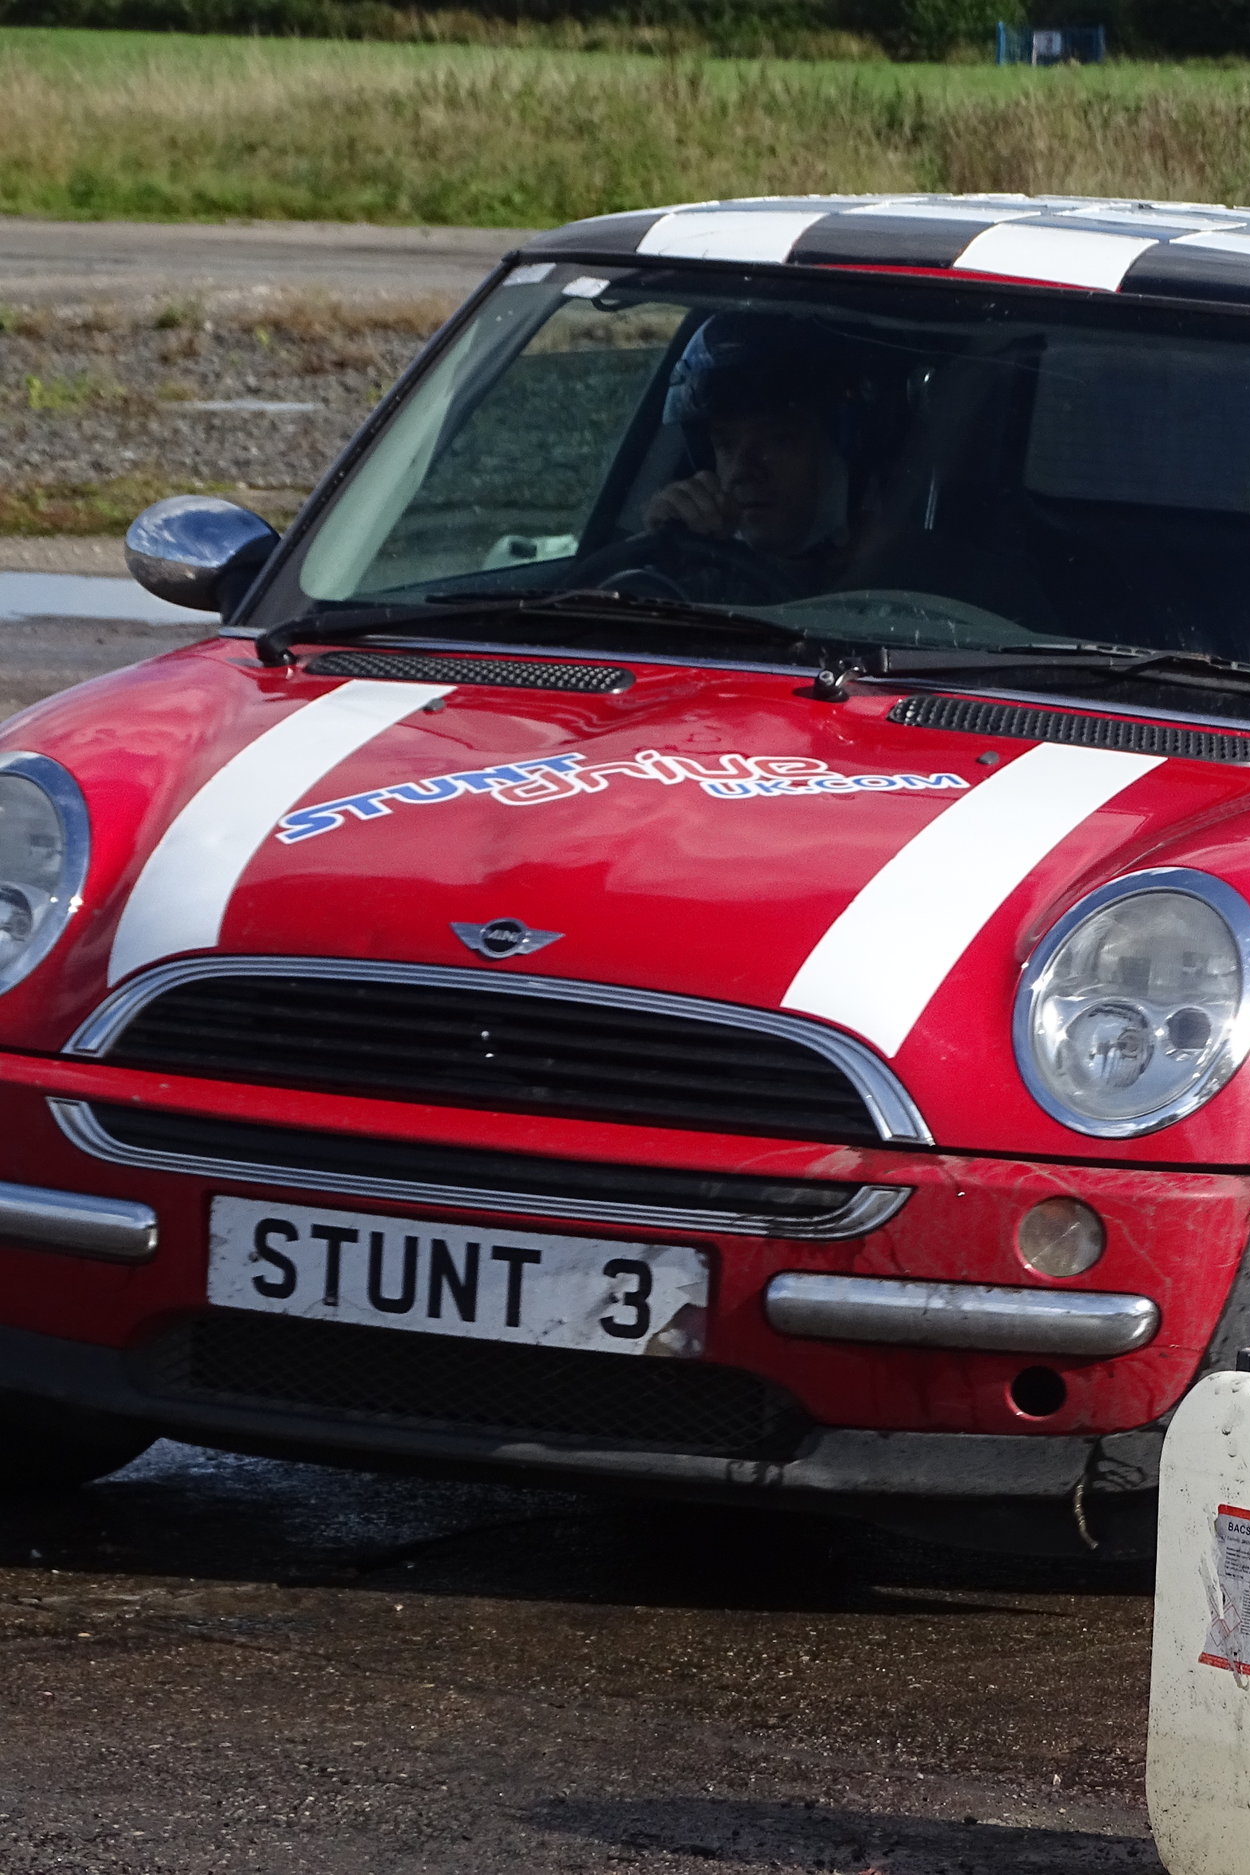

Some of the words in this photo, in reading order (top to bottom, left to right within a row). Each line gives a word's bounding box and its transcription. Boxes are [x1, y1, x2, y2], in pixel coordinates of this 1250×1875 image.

[276, 753, 586, 843] STUNT
[492, 750, 829, 805] drive
[703, 773, 970, 799] UK.COM
[252, 1218, 542, 1328] STUNT
[599, 1258, 653, 1339] 3
